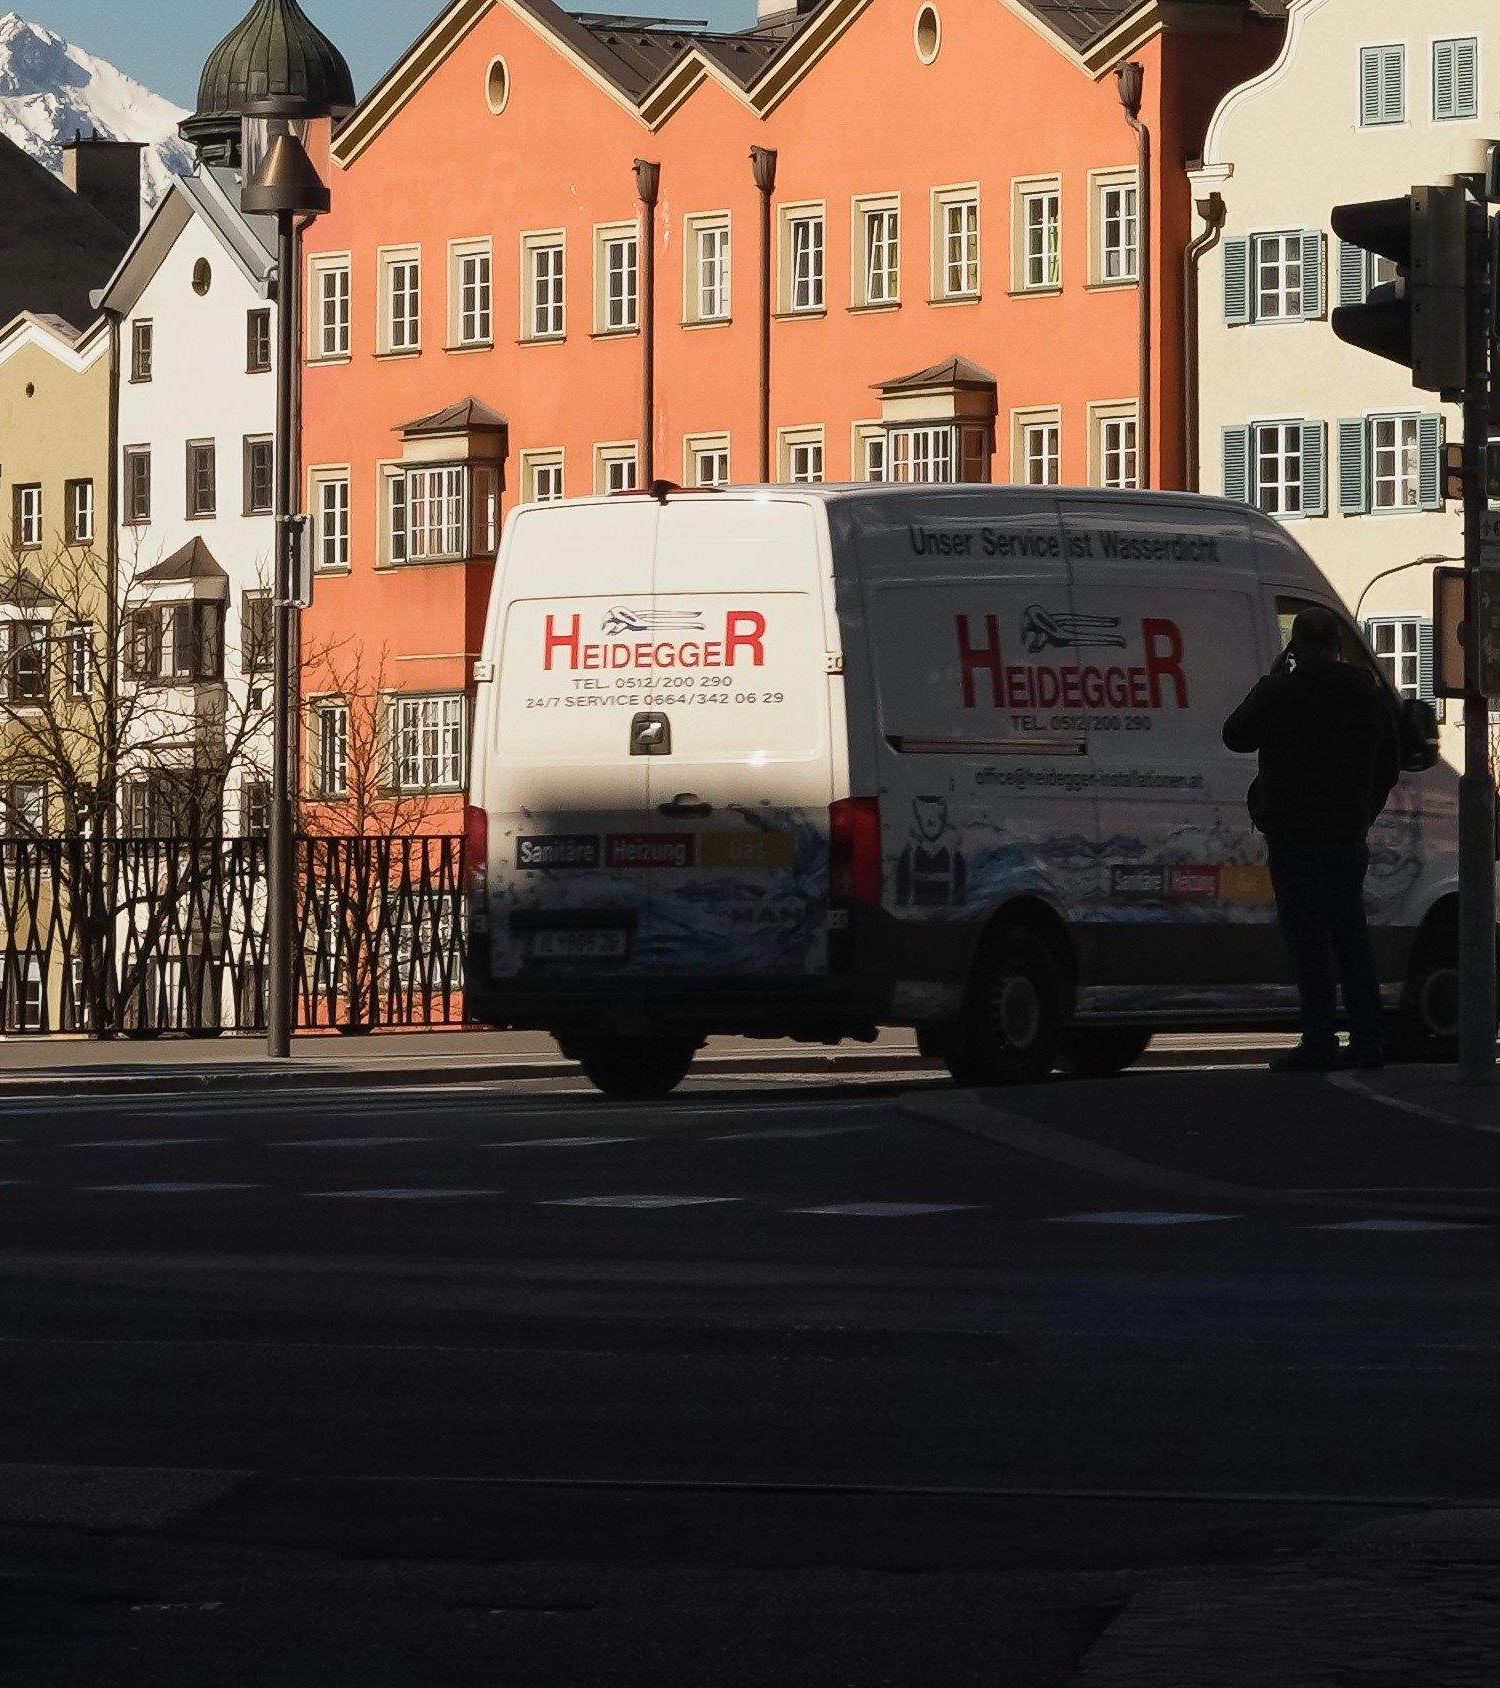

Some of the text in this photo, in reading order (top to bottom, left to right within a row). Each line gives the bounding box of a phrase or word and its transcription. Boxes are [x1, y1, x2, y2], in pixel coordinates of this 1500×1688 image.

[909, 524, 1220, 562] Unser Service ist Wasserdicht
[543, 610, 767, 671] HEIDEGGER
[955, 614, 1189, 709] HEIDEGGER
[572, 675, 733, 690] TEL. 0512/200 290
[526, 692, 785, 709] 24/7 SERVICE 0664/342 06 29
[1011, 715, 1046, 731] TEL.
[520, 840, 595, 864] Sanitäre
[614, 839, 687, 866] Heizung
[729, 838, 765, 861] Gas
